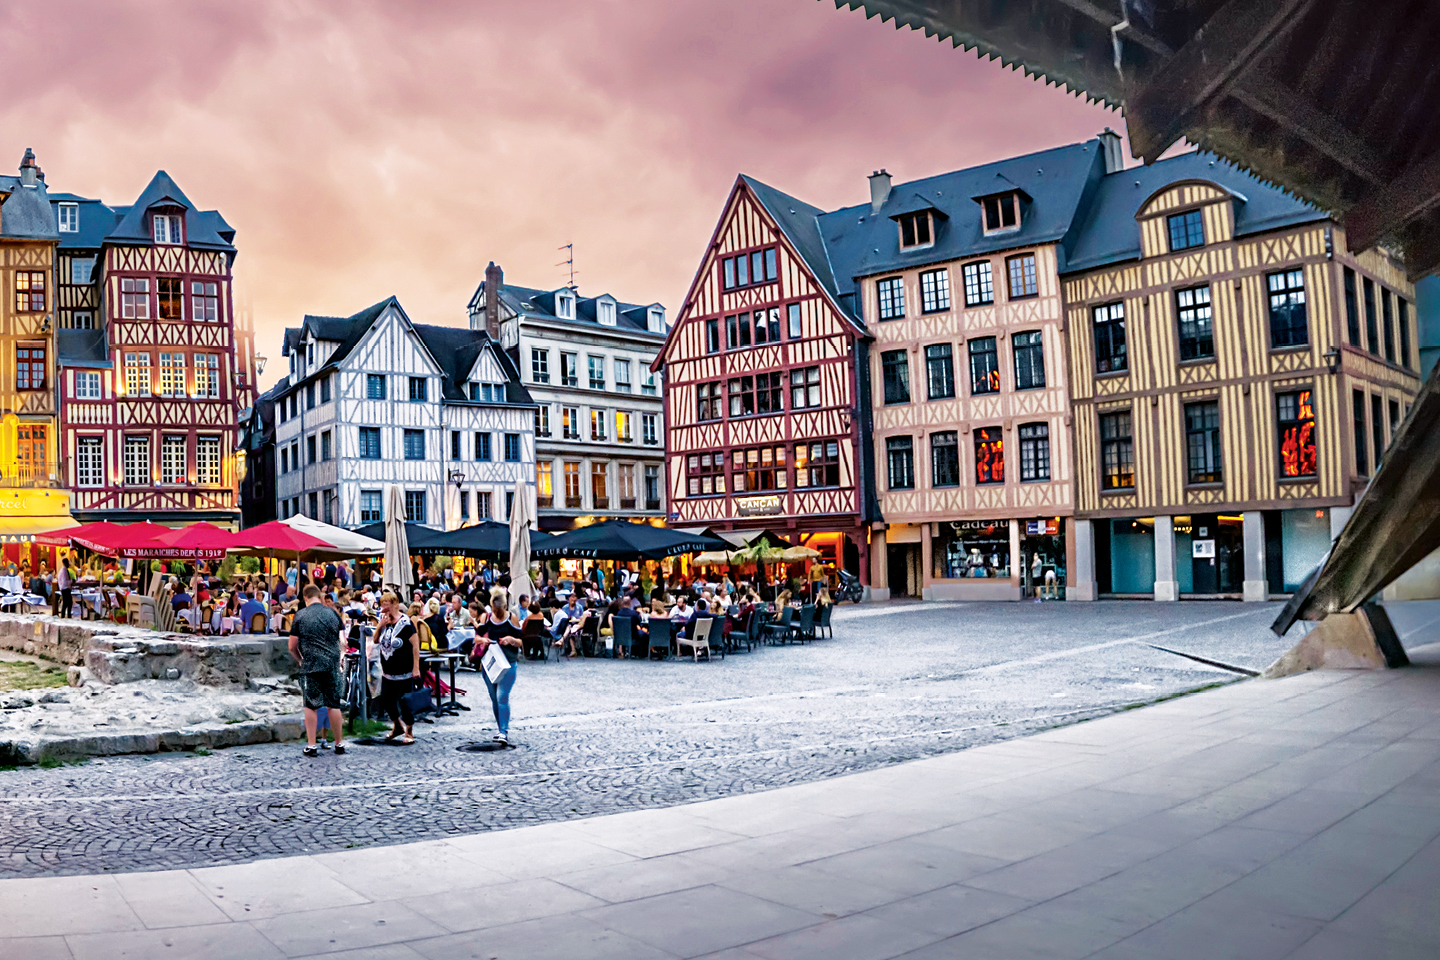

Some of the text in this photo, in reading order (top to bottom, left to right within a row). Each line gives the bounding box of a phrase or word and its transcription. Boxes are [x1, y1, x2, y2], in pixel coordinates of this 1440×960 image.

[740, 499, 779, 509] CANCAN
[123, 548, 137, 557] LES
[536, 547, 569, 557] L'EURO
